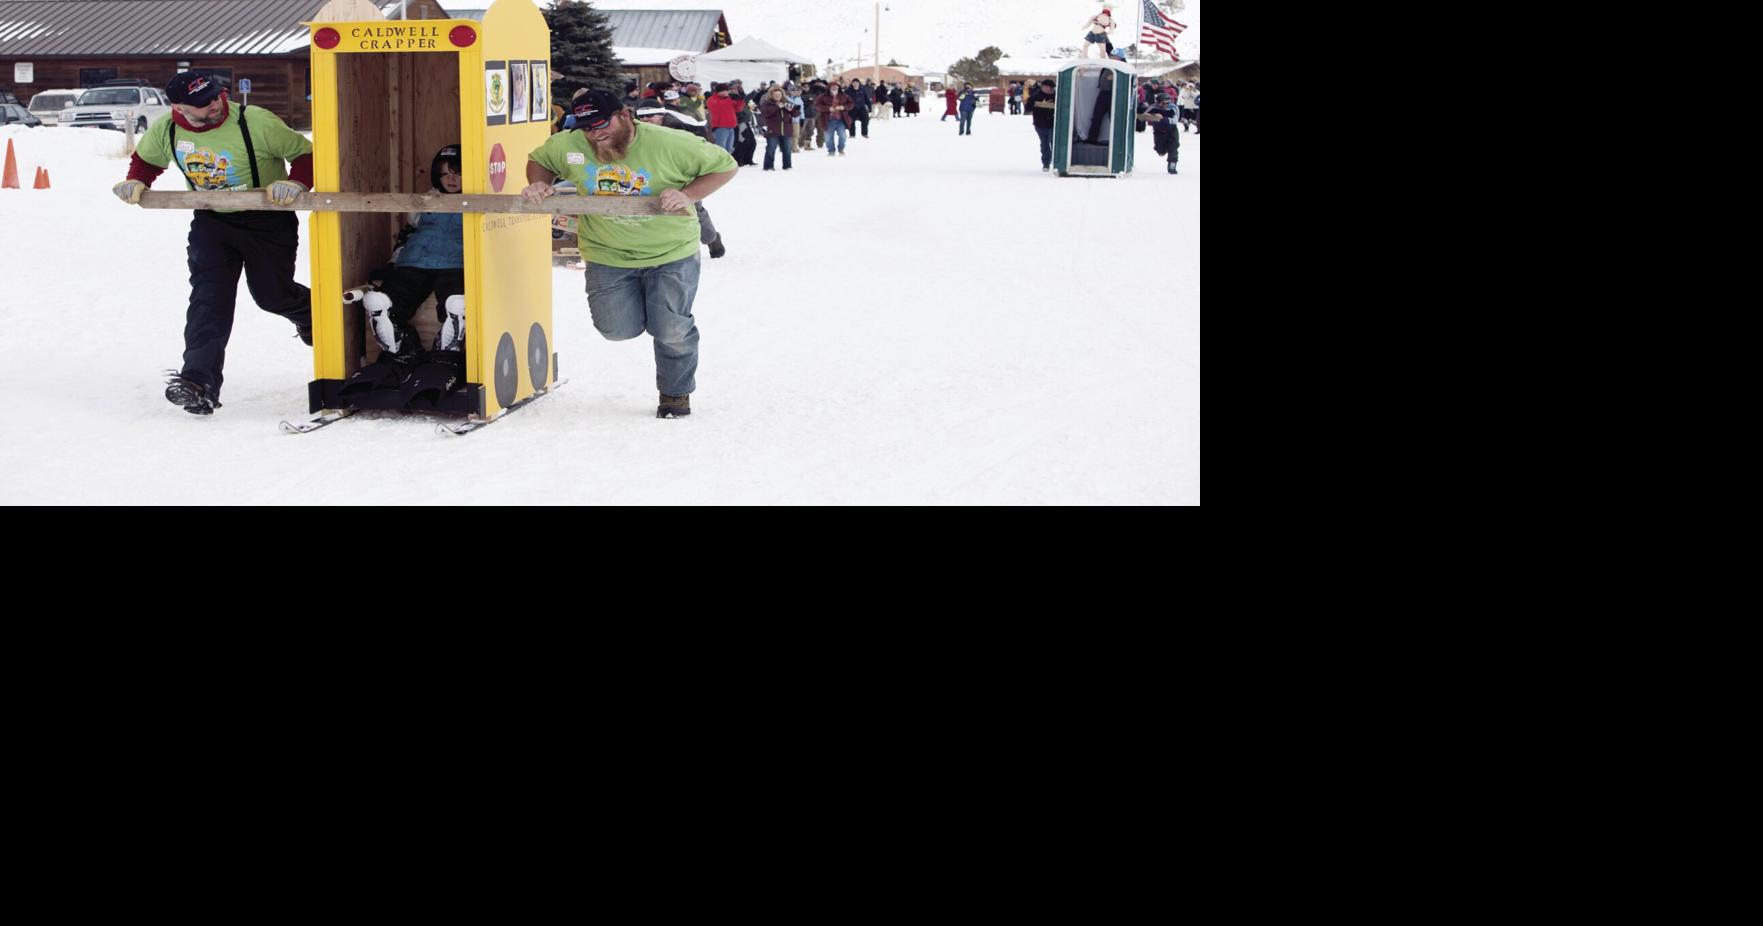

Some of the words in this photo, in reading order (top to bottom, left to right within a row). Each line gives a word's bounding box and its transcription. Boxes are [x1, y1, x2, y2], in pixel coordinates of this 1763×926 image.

[352, 27, 440, 38] CALDWELL
[360, 39, 437, 50] CRAPPER
[490, 161, 505, 174] STOP
